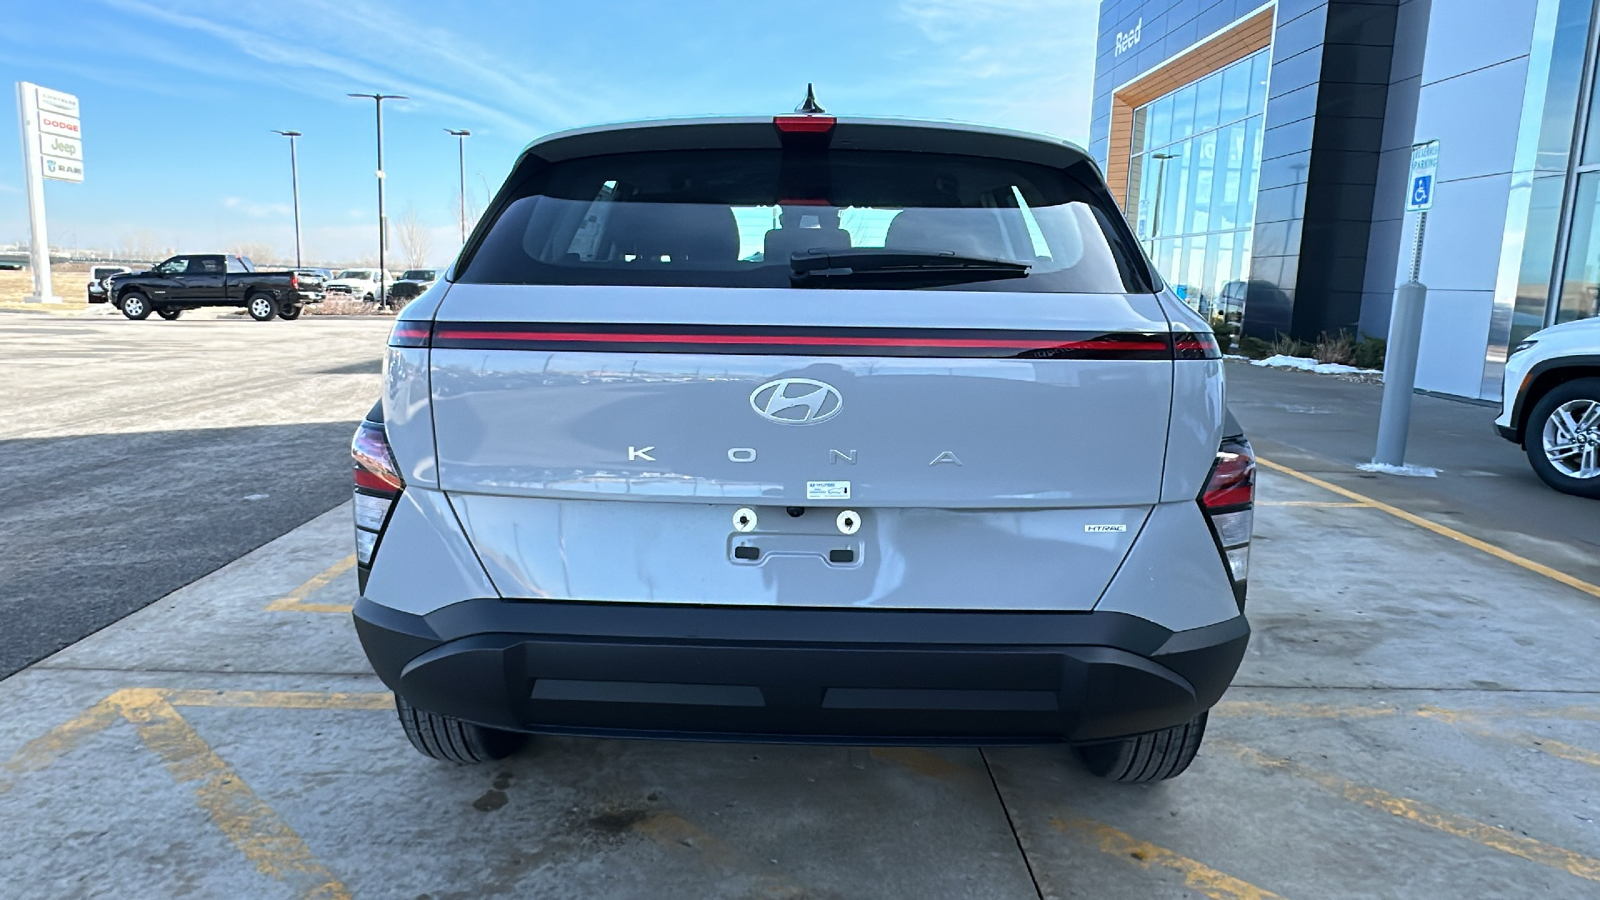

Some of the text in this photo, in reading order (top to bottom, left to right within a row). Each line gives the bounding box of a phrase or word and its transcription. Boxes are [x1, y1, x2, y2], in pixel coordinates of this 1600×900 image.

[1114, 17, 1142, 57] Reed
[43, 118, 79, 132] DODGE
[51, 138, 76, 156] Jeep
[58, 164, 82, 175] RAM
[1412, 157, 1437, 170] PARKING
[628, 446, 963, 467] KONA
